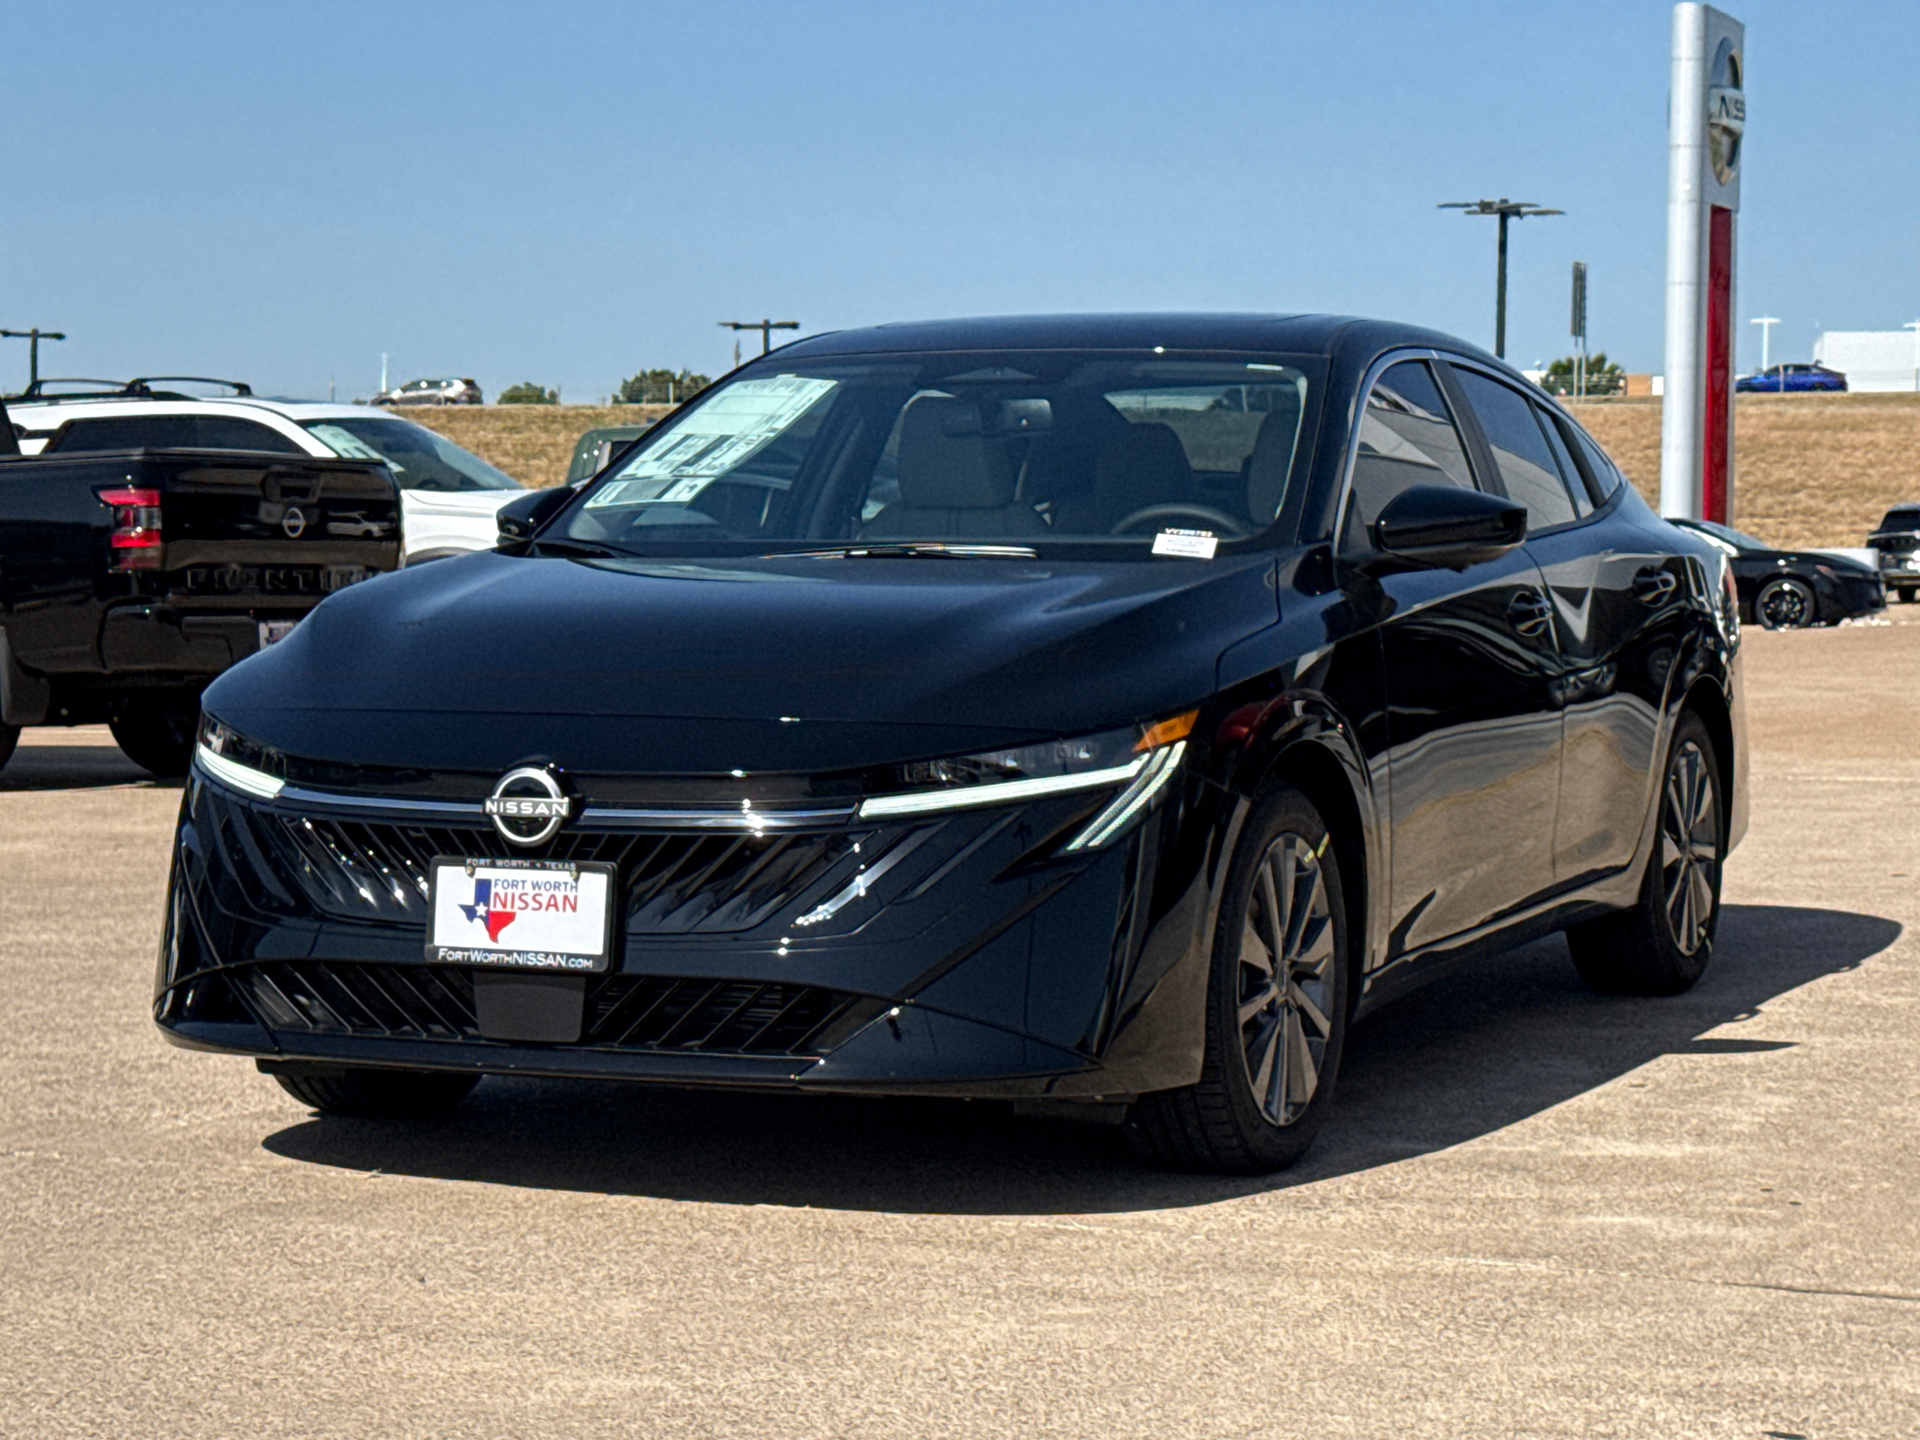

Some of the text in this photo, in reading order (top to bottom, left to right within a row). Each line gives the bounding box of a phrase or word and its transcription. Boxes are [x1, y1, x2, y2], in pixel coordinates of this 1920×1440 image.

[485, 800, 568, 816] NISSAN
[466, 858, 577, 871] FORT WORTH TEXAS
[493, 878, 579, 893] FORT WORTH
[492, 891, 578, 913] NISSAN
